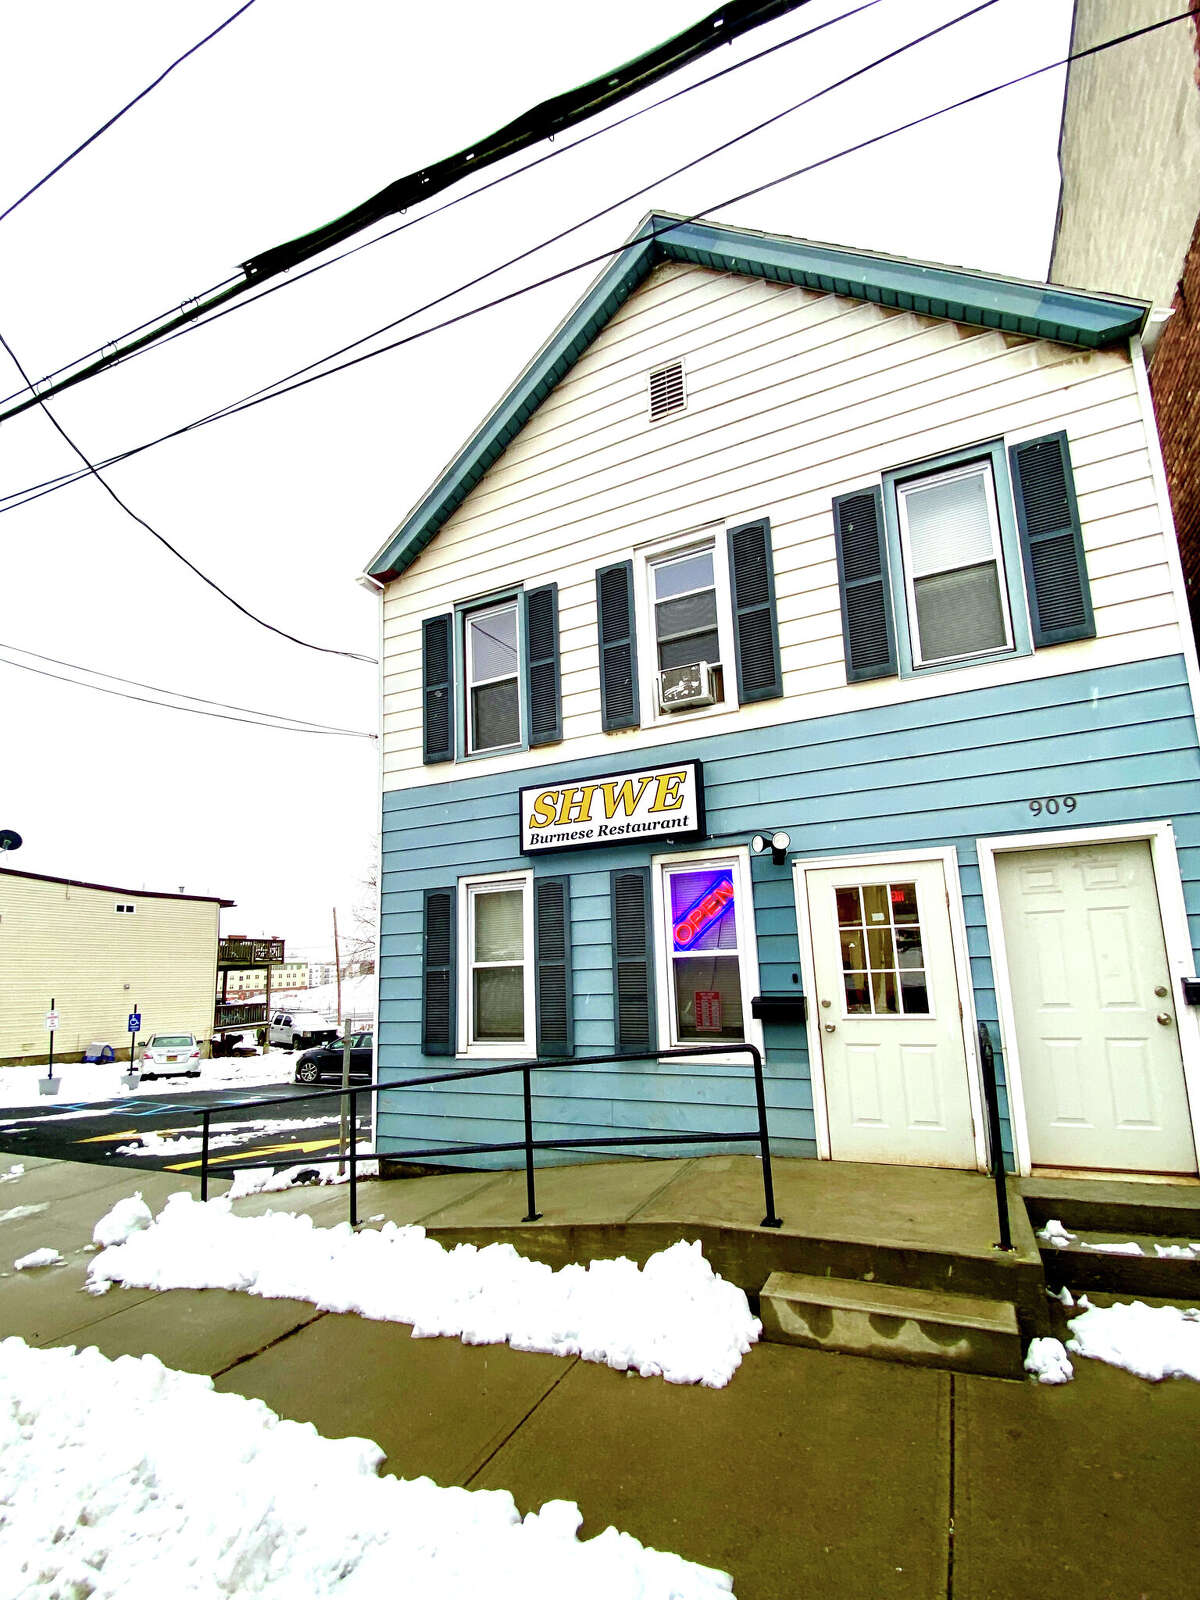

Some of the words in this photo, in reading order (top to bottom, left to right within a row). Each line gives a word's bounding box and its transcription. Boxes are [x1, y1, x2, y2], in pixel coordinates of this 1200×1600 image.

[529, 771, 687, 829] SHWE
[1029, 796, 1077, 817] 909
[529, 827, 594, 846] Burmese
[598, 815, 689, 837] Restaurant
[674, 880, 734, 945] OPEN
